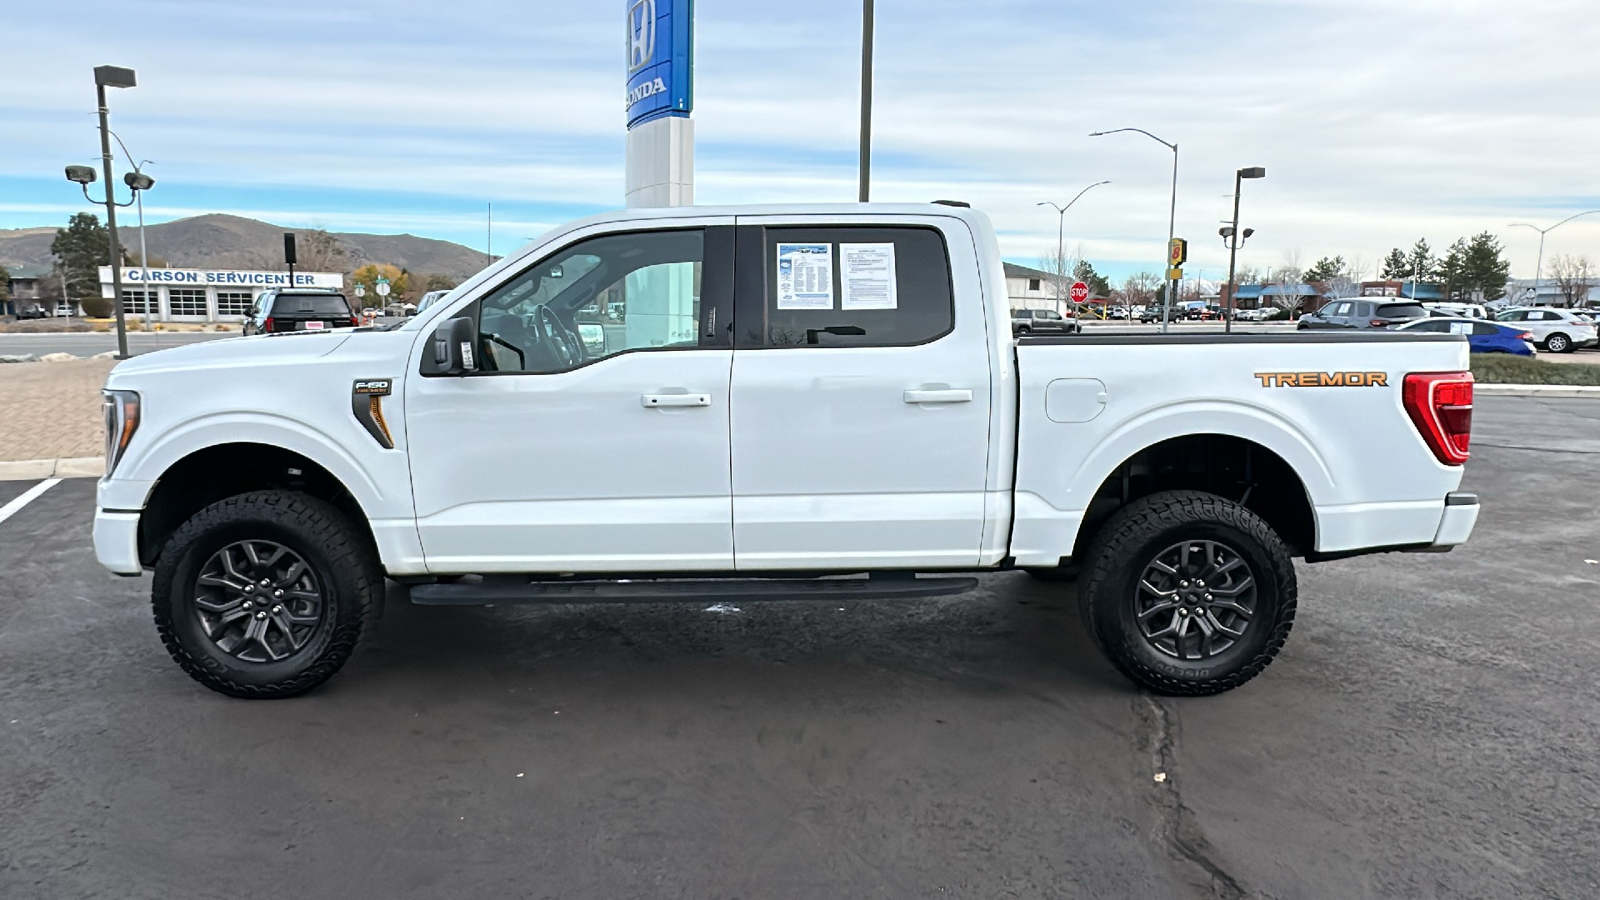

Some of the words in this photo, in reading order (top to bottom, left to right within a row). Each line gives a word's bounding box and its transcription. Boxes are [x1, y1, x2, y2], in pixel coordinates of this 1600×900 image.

[626, 77, 667, 109] ONDA
[1172, 246, 1181, 260] 8
[128, 270, 198, 283] CARSON
[1071, 287, 1088, 297] STOP
[355, 381, 389, 389] F-150
[1254, 372, 1389, 388] TREMOR
